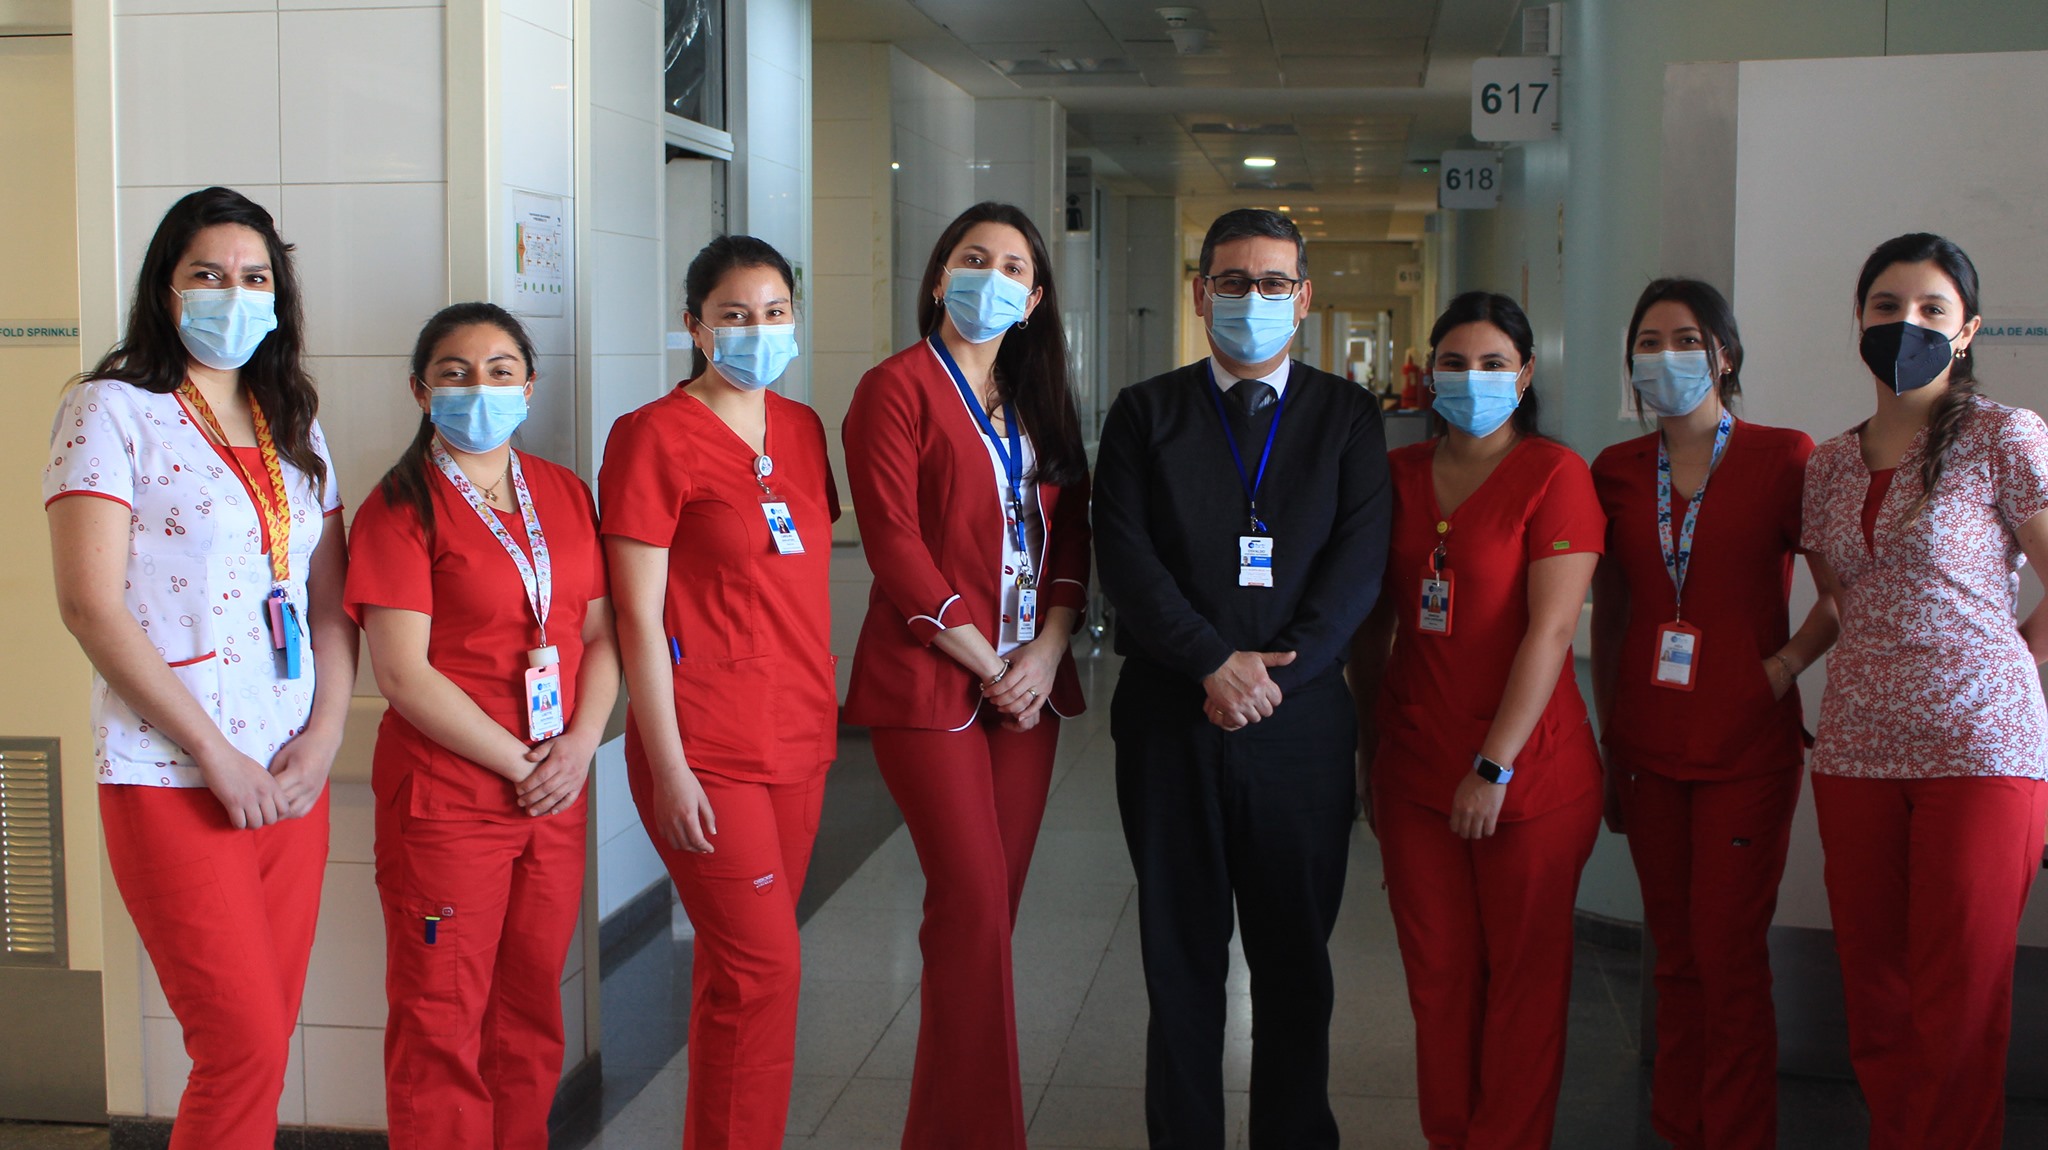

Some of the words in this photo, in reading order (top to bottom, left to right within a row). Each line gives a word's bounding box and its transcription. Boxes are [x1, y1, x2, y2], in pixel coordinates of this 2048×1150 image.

[1480, 83, 1549, 114] 617
[1446, 168, 1494, 190] 618
[27, 328, 79, 337] SPRINKLE
[2008, 327, 2022, 336] DE
